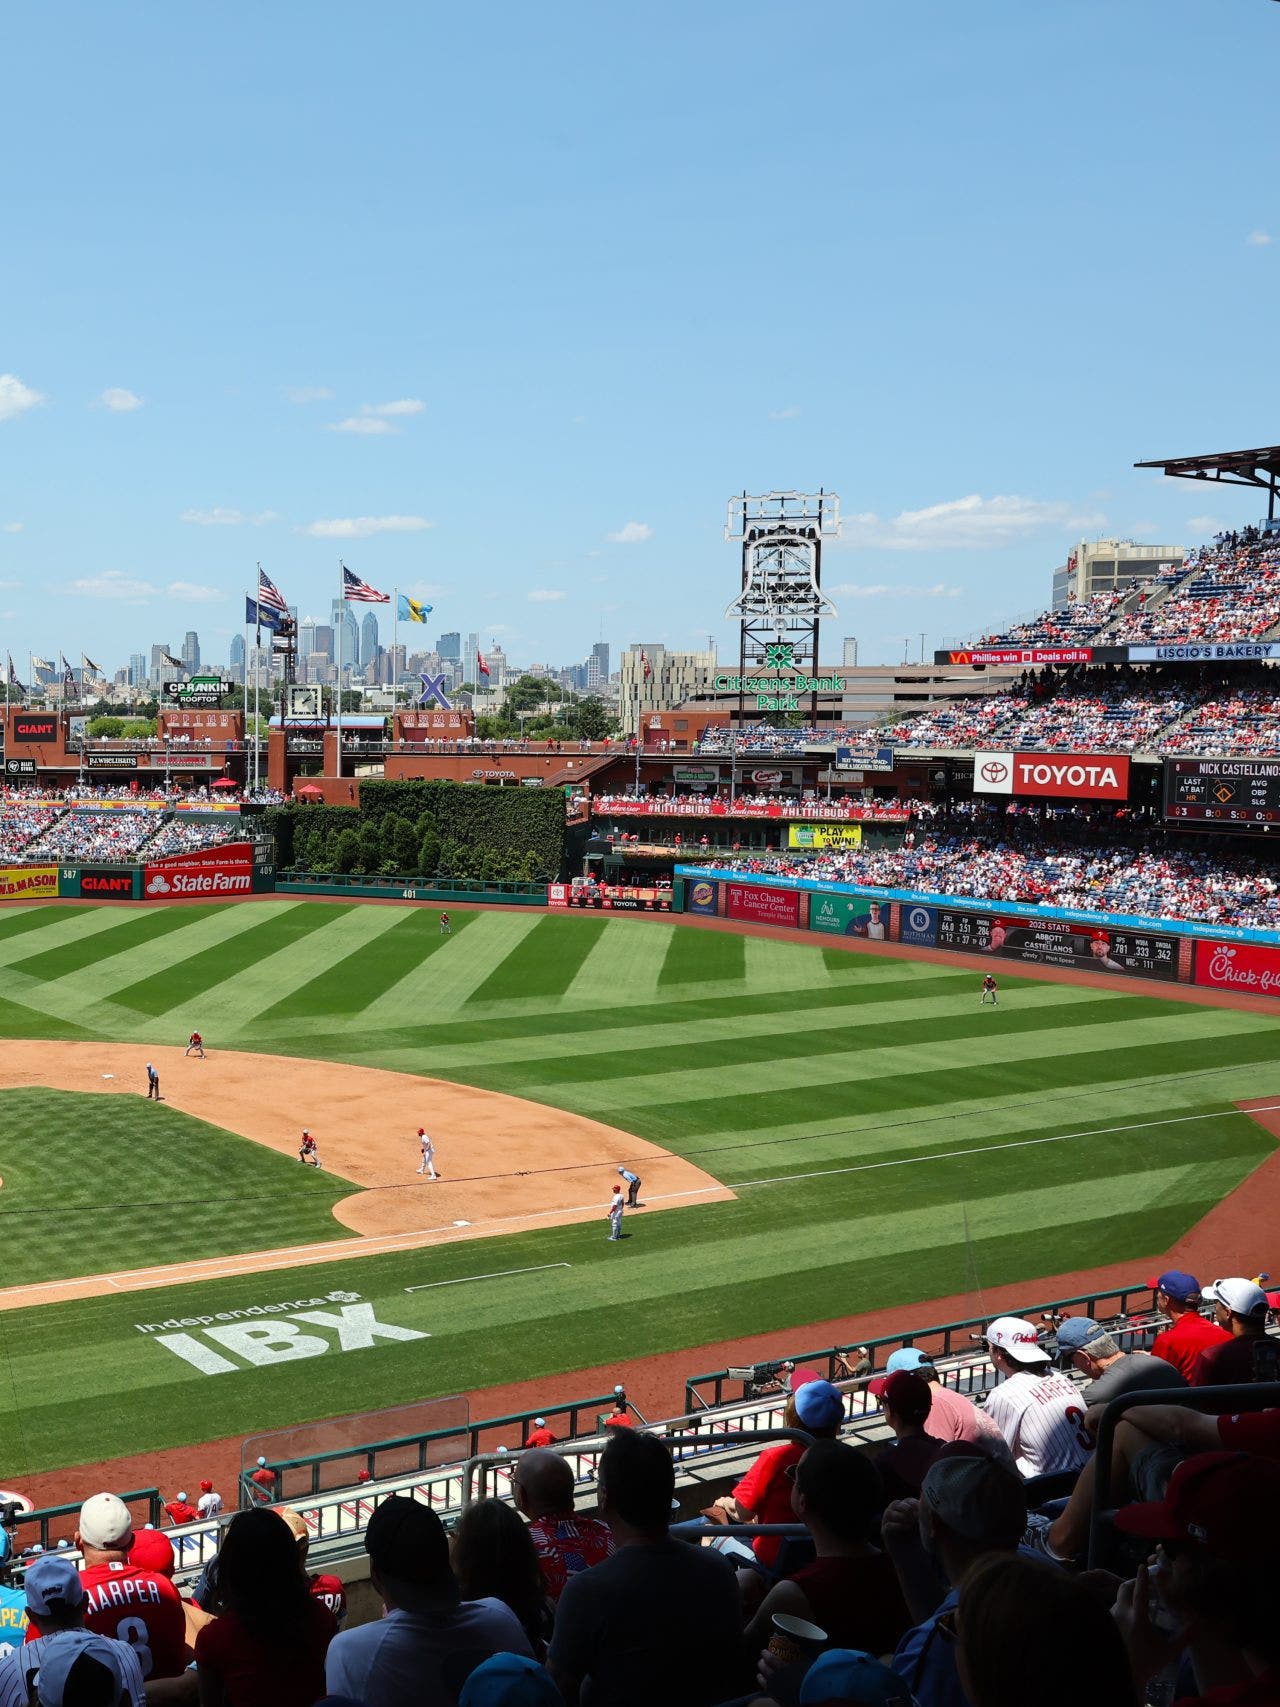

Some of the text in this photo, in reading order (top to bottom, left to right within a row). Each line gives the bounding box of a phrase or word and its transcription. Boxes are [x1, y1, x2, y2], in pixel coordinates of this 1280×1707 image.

[972, 652, 1088, 662] Phillies win Deals roll in
[1157, 644, 1272, 659] LISCIO'S BAKERY
[169, 682, 229, 692] CP RANKIN
[714, 674, 843, 691] Citizens Bank
[757, 694, 799, 711] Park
[18, 724, 53, 734] GIANT
[484, 770, 515, 778] TOYOTA
[1200, 763, 1220, 774] NICK
[1019, 764, 1118, 788] TOYOTA
[596, 802, 640, 812] Budweiser
[724, 804, 770, 816] Budweiser
[820, 827, 844, 836] PLAY
[64, 870, 76, 880] 387
[260, 866, 272, 875] 409
[82, 878, 132, 890] GIANT
[402, 889, 416, 900] 401
[744, 890, 785, 904] Fox Chase
[744, 900, 795, 913] Cancer Center
[778, 912, 794, 920] Health
[1064, 910, 1103, 921] Independence
[1028, 920, 1070, 932] 2025 STATS
[1138, 919, 1162, 928] ibx.com
[1192, 926, 1236, 936] Independence
[1036, 933, 1063, 942] ABBOTT
[1024, 942, 1072, 954] CASTELLANOS
[134, 1296, 328, 1334] Independence
[154, 1302, 432, 1376] IBX
[1028, 1378, 1080, 1406] HARPER
